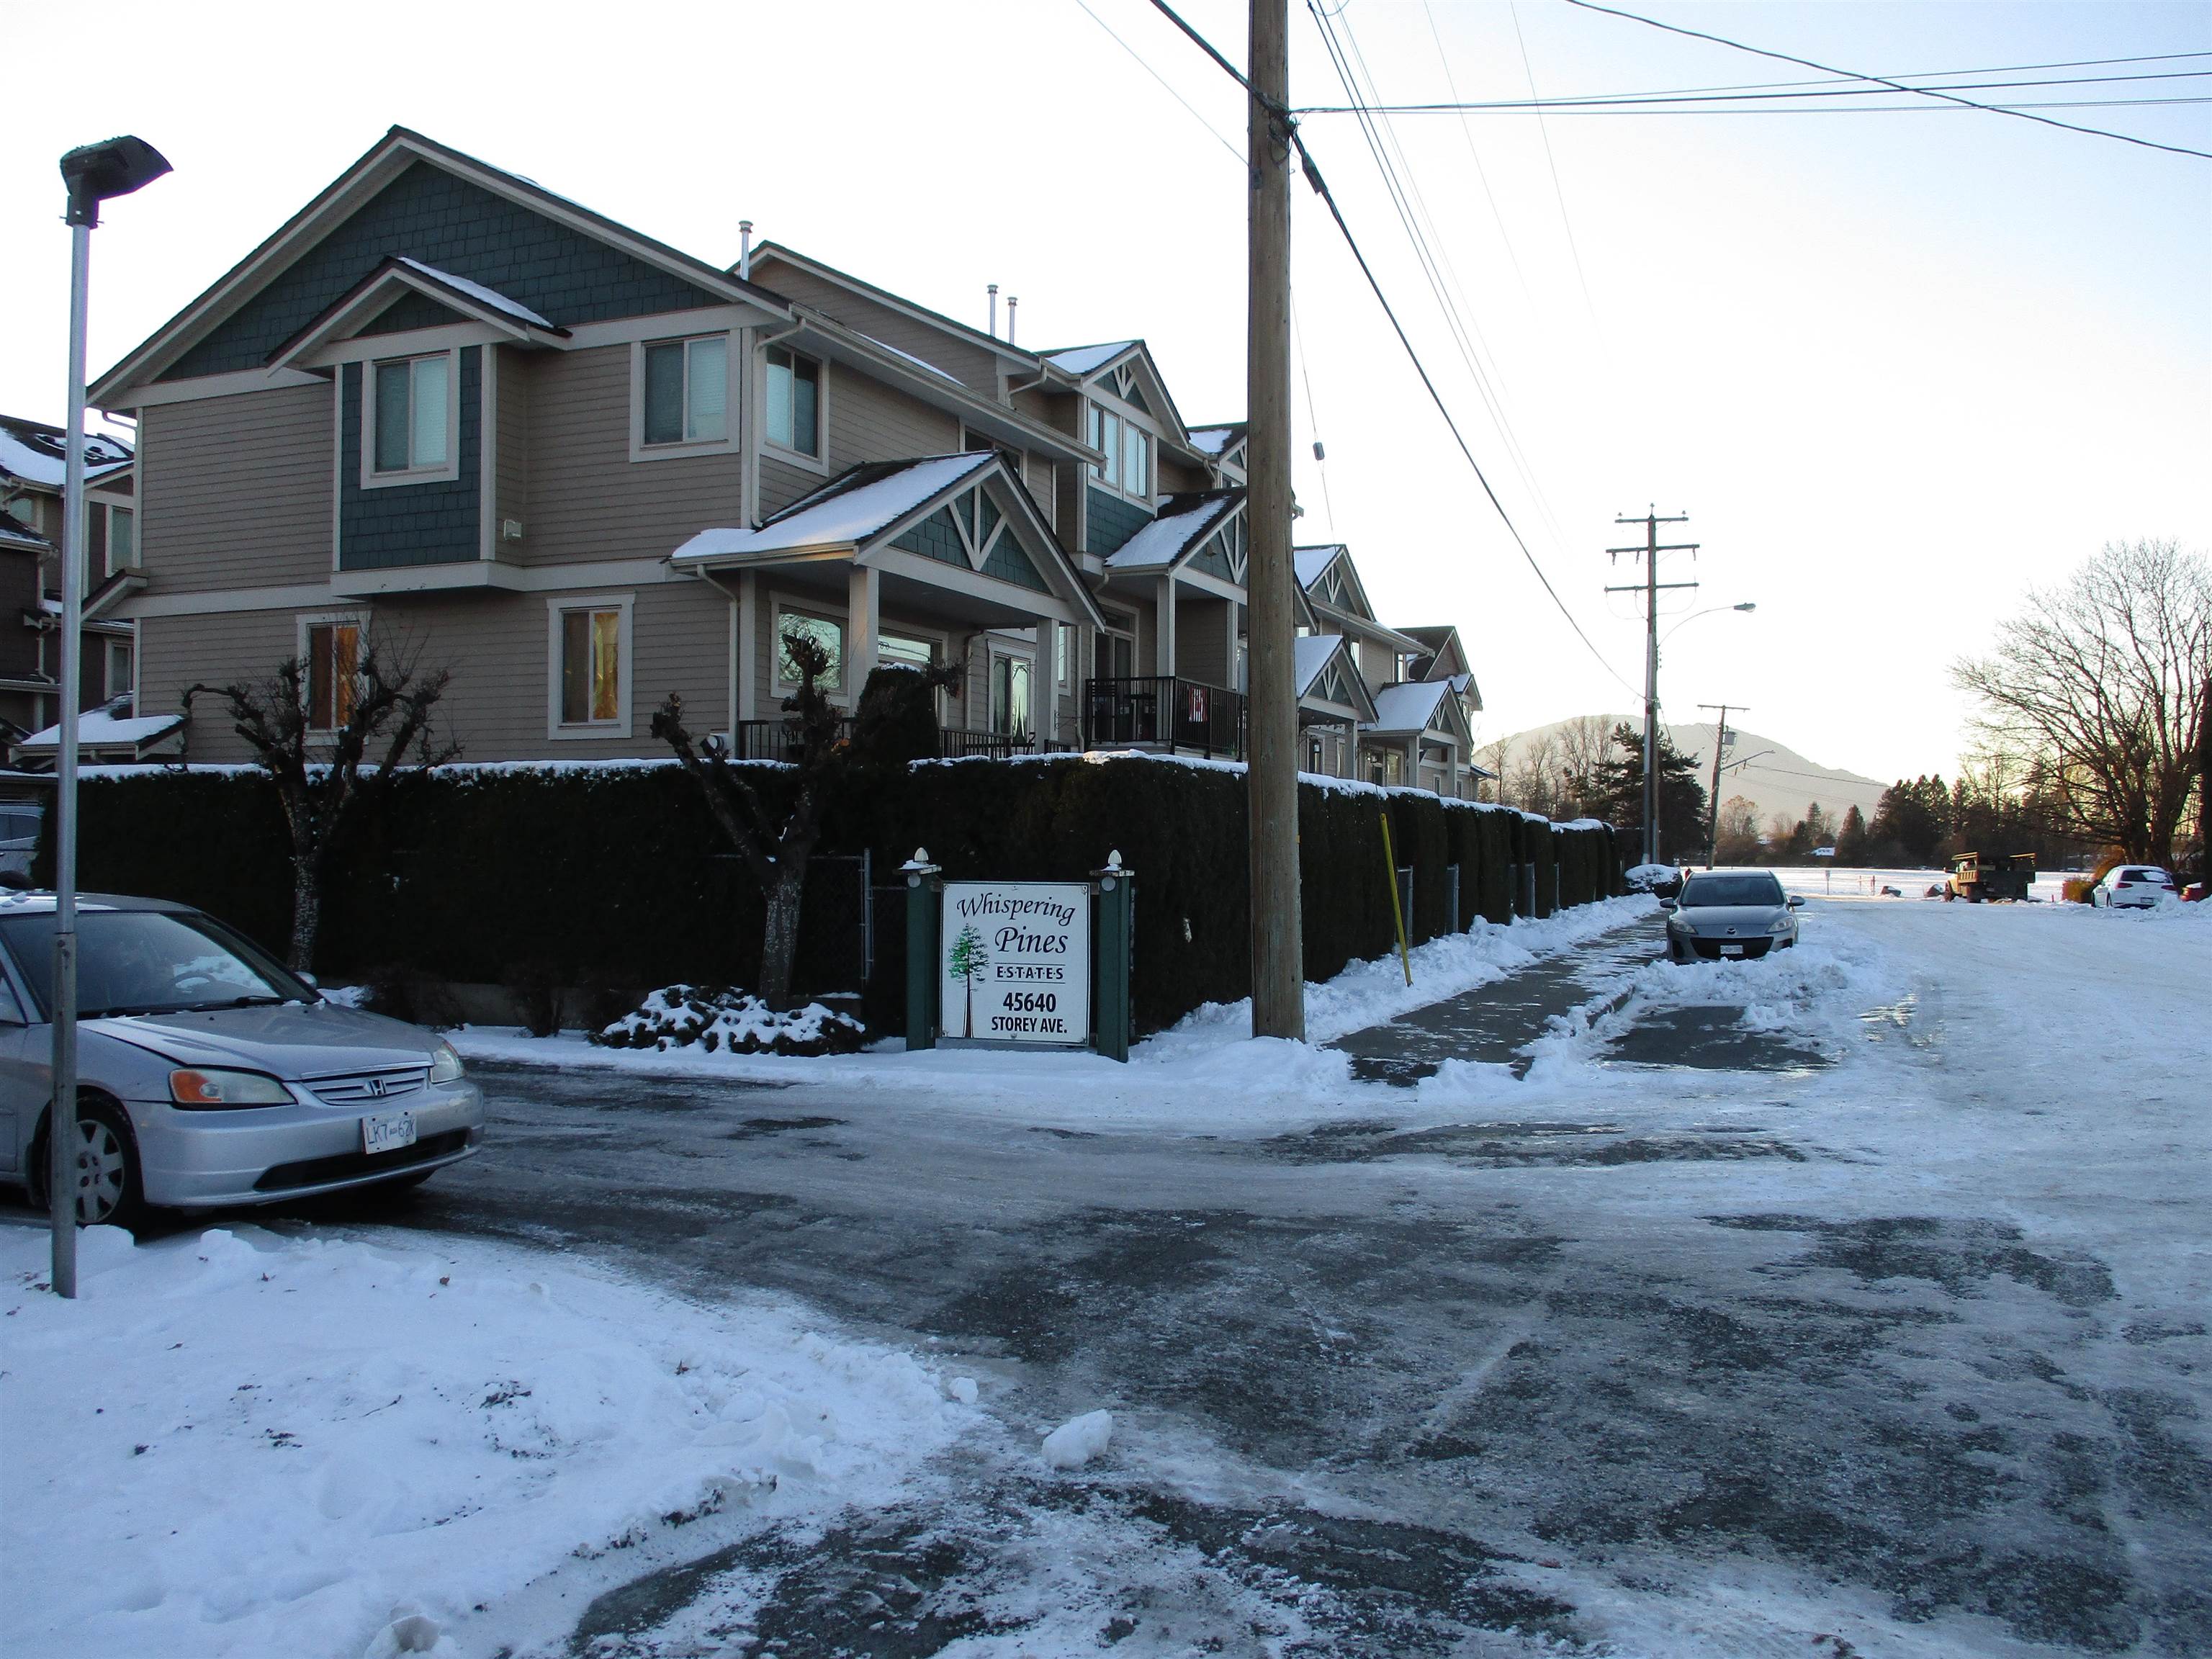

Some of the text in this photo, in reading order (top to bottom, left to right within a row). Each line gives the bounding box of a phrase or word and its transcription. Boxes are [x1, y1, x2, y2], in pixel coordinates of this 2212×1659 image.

[956, 892, 1076, 927] Whispering
[994, 926, 1069, 953] Pines
[1003, 992, 1056, 1012] 45640
[991, 1016, 1067, 1033] STOREY AVE.
